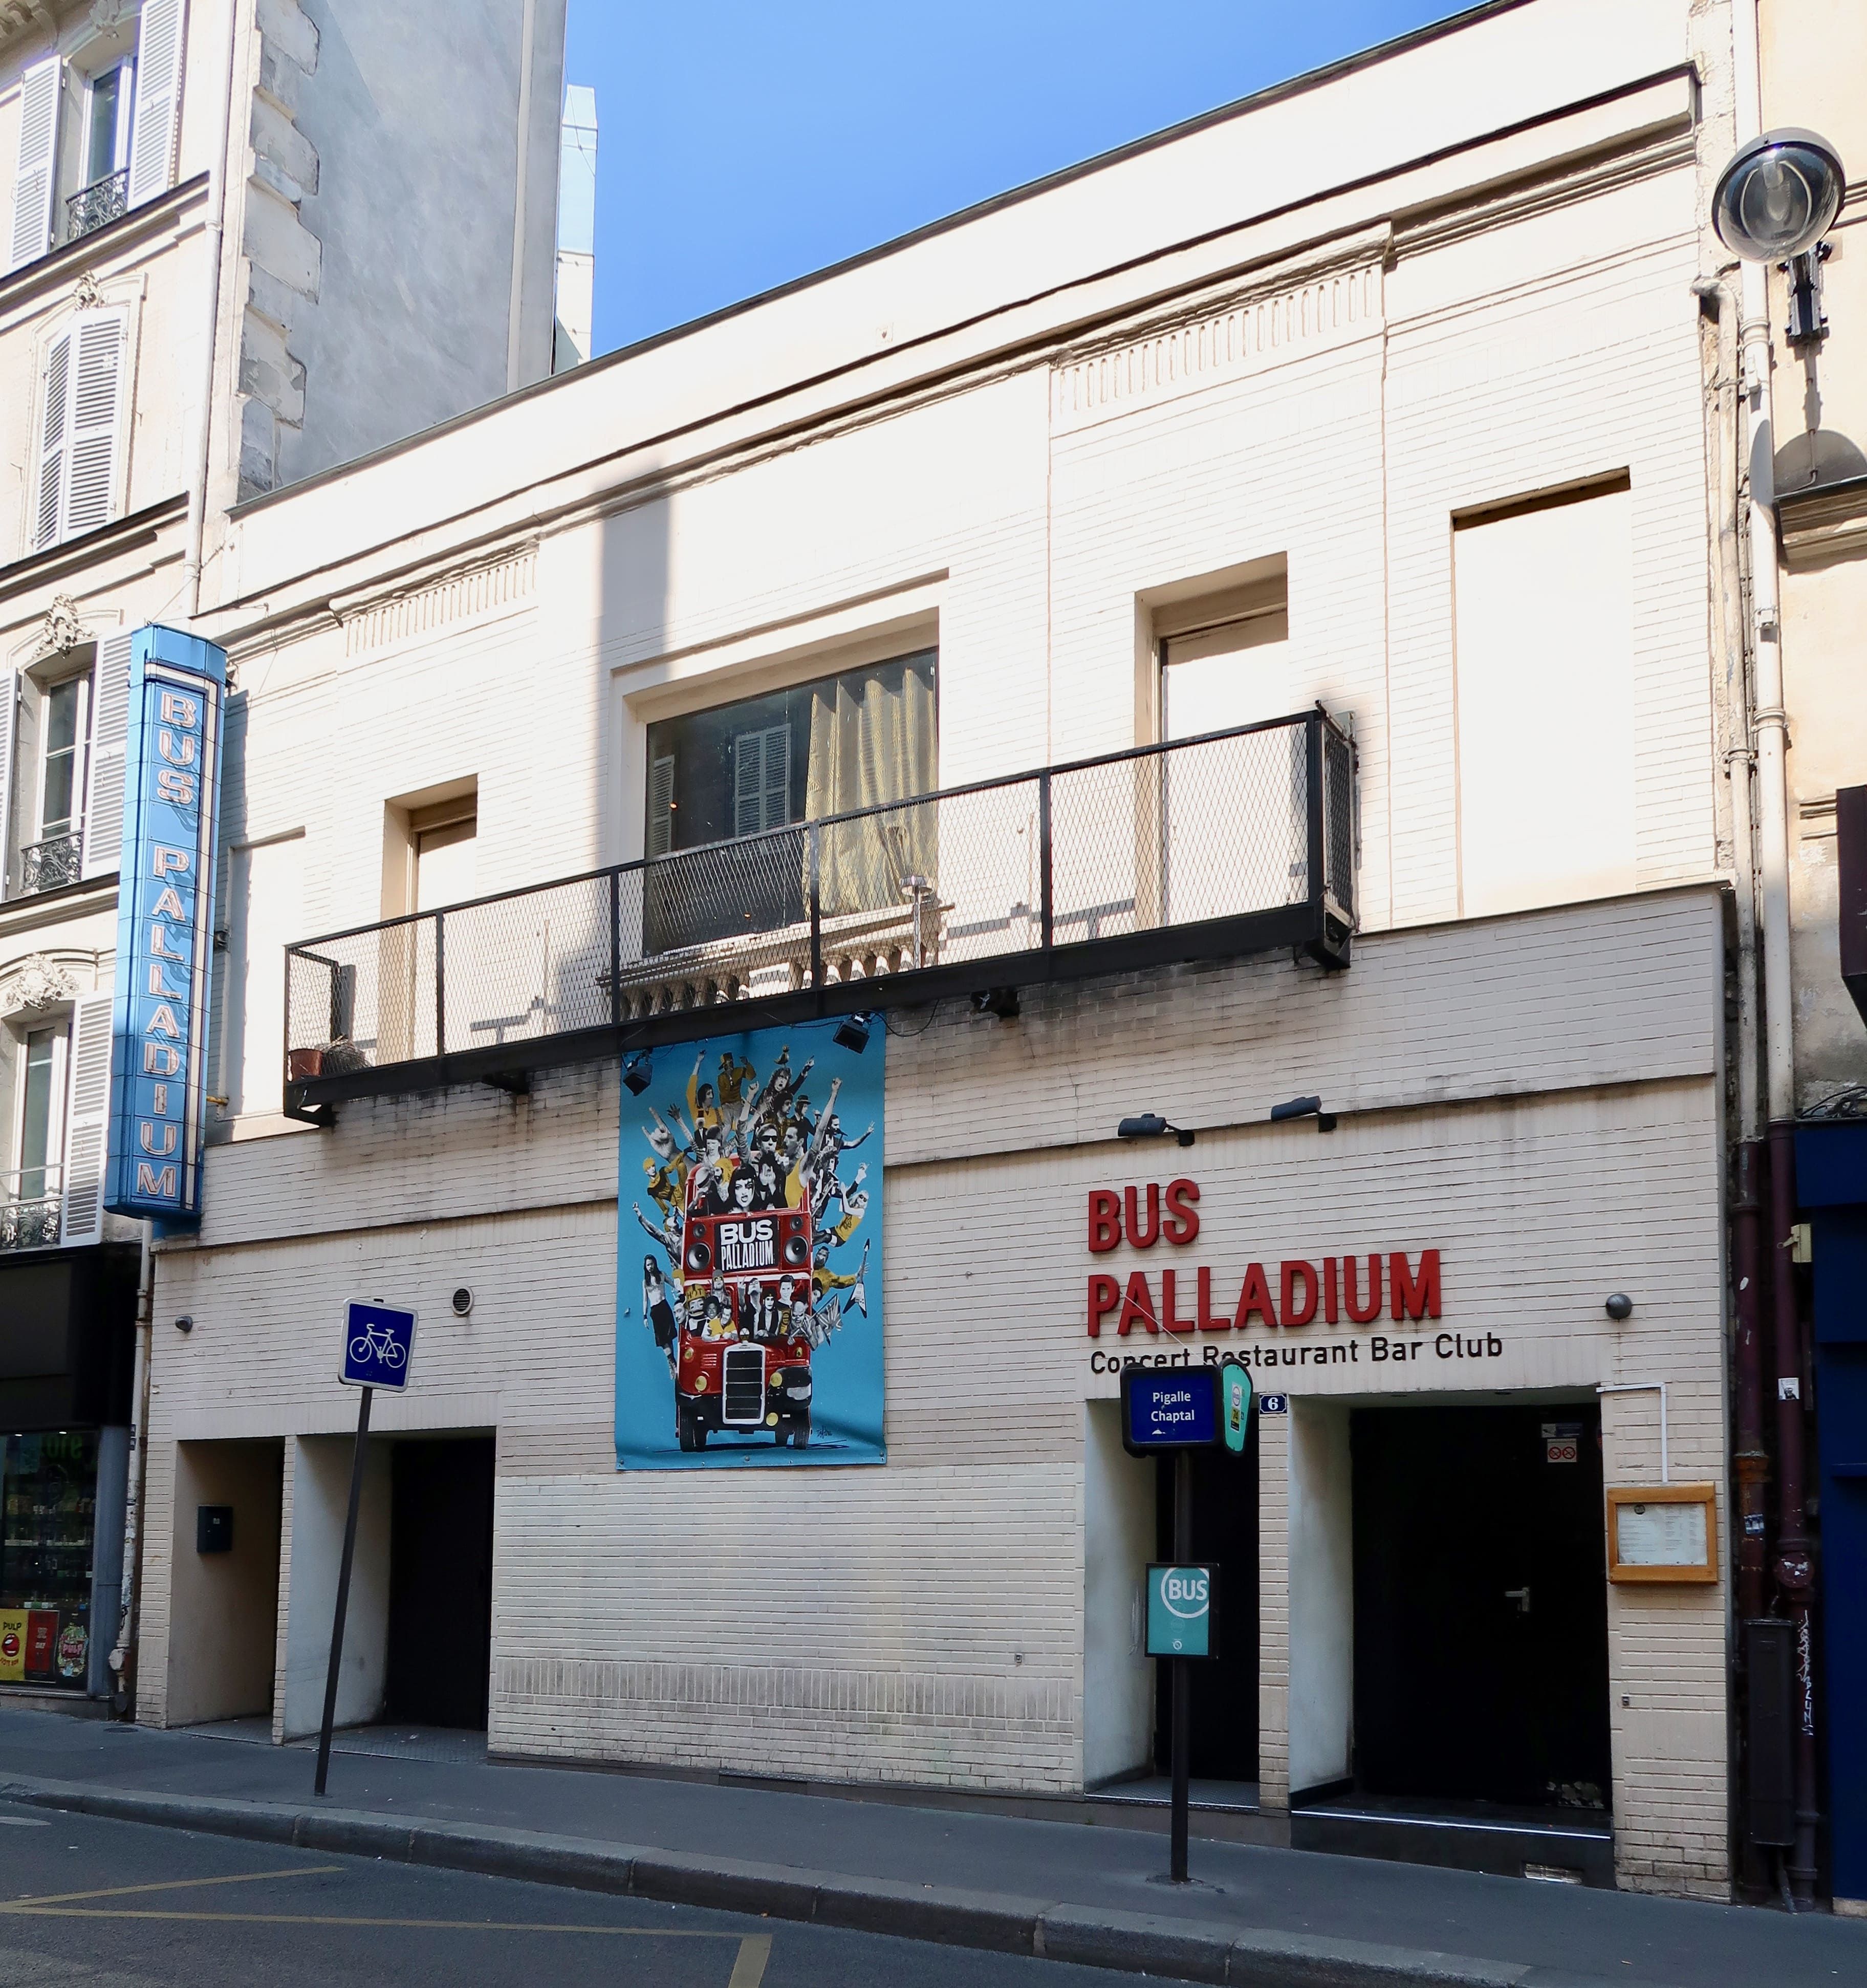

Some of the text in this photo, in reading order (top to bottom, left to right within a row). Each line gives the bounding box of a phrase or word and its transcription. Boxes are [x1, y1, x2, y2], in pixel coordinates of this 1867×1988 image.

[157, 691, 197, 805] BUS
[136, 845, 190, 1197] PALLADIUM
[1088, 1178, 1201, 1253] BUS
[720, 1219, 773, 1246] BUS
[721, 1240, 774, 1271] PALLADIUM
[1088, 1249, 1442, 1337] PALLADIUM
[1371, 1336, 1423, 1362] Bar
[1435, 1332, 1503, 1359] Club
[1153, 1391, 1191, 1405] Pigalle
[1268, 1397, 1278, 1410] 6
[1150, 1410, 1195, 1423] Chaptal
[1168, 1579, 1208, 1601] BUS
[3, 1621, 22, 1631] PULP
[62, 1643, 83, 1655] PULP
